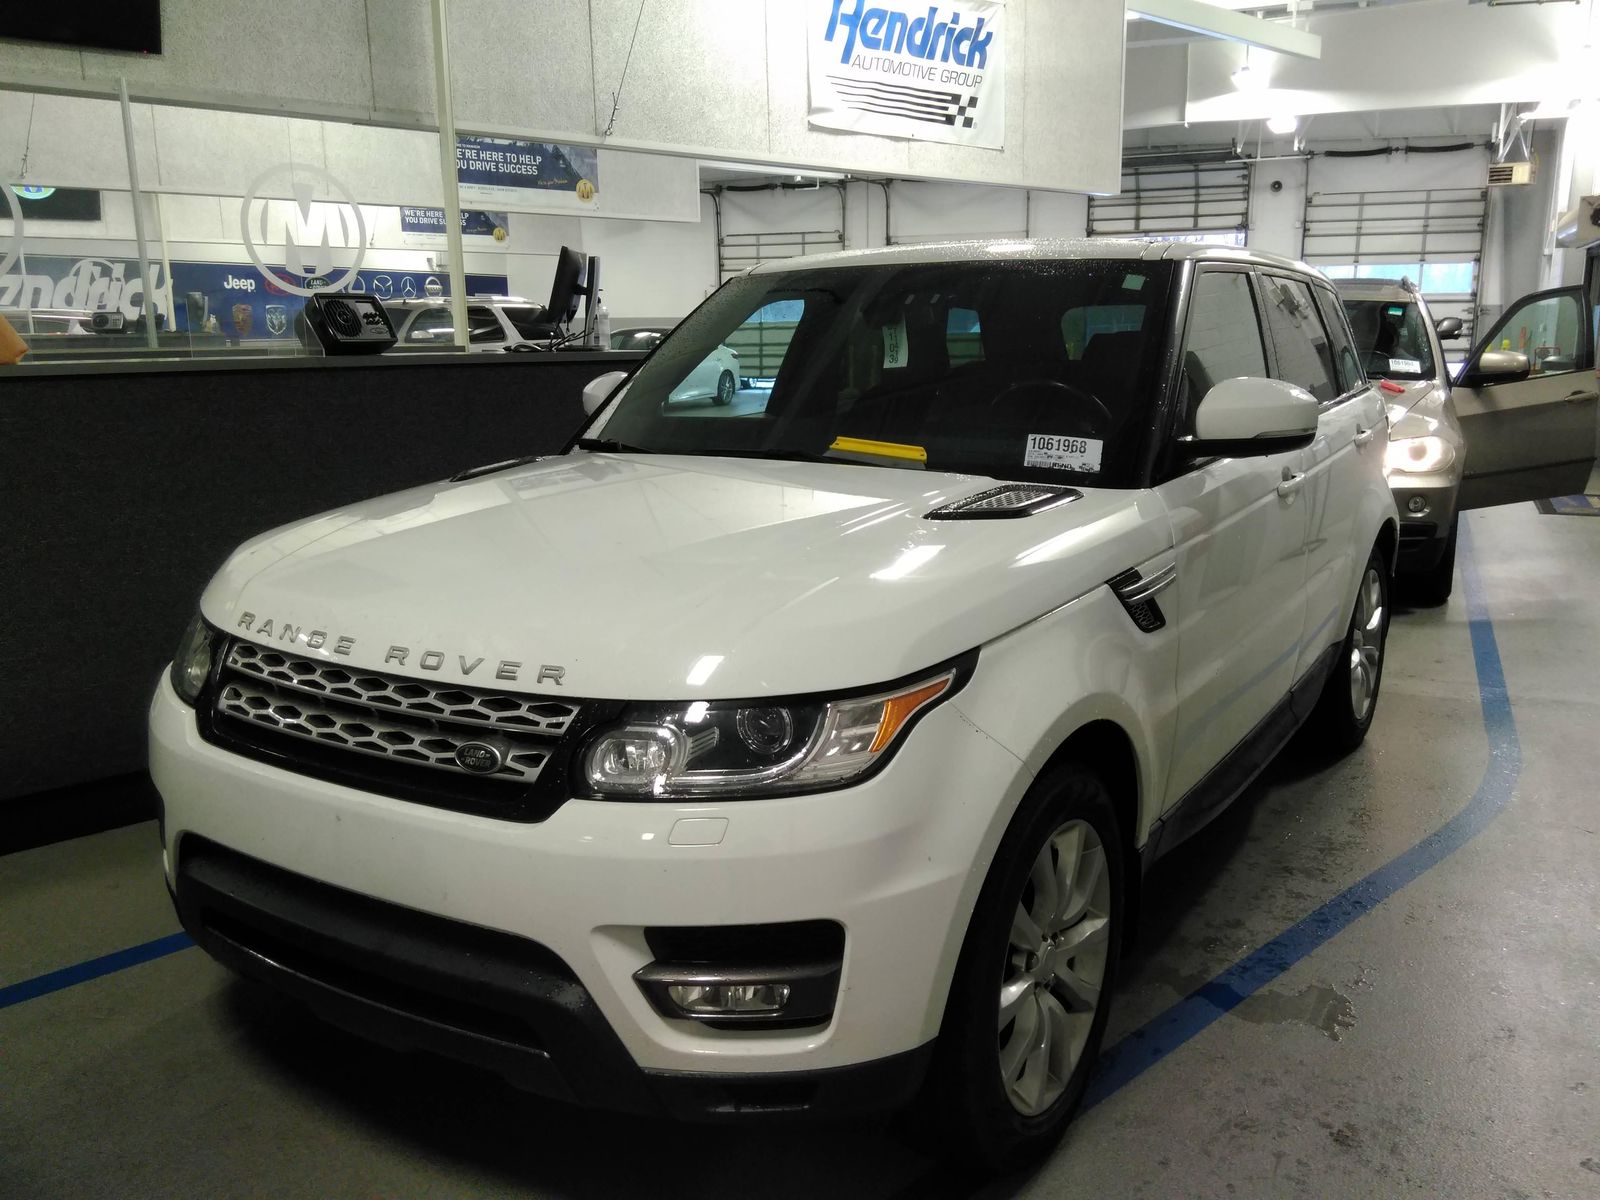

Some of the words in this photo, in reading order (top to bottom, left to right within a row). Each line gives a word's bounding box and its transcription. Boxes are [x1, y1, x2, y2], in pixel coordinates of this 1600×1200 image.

[824, 0, 994, 70] Hendrick
[851, 54, 938, 82] AUTOMOTIVE
[940, 69, 983, 88] GROUP
[457, 149, 478, 160] E'RE
[480, 150, 505, 162] HERE
[506, 153, 517, 162] TO
[519, 154, 542, 165] HELP
[456, 160, 467, 169] OU
[470, 161, 497, 172] DRIVE
[498, 164, 538, 176] SUCCESS
[404, 209, 425, 217] WE'RE
[426, 210, 443, 218] HERE
[405, 216, 419, 224] YOU
[419, 217, 438, 225] DRIVE
[224, 275, 255, 292] Jeep
[1030, 436, 1087, 454] 1061968
[237, 611, 357, 656] RANGE
[385, 645, 566, 686] ROVER
[464, 747, 486, 758] LAND
